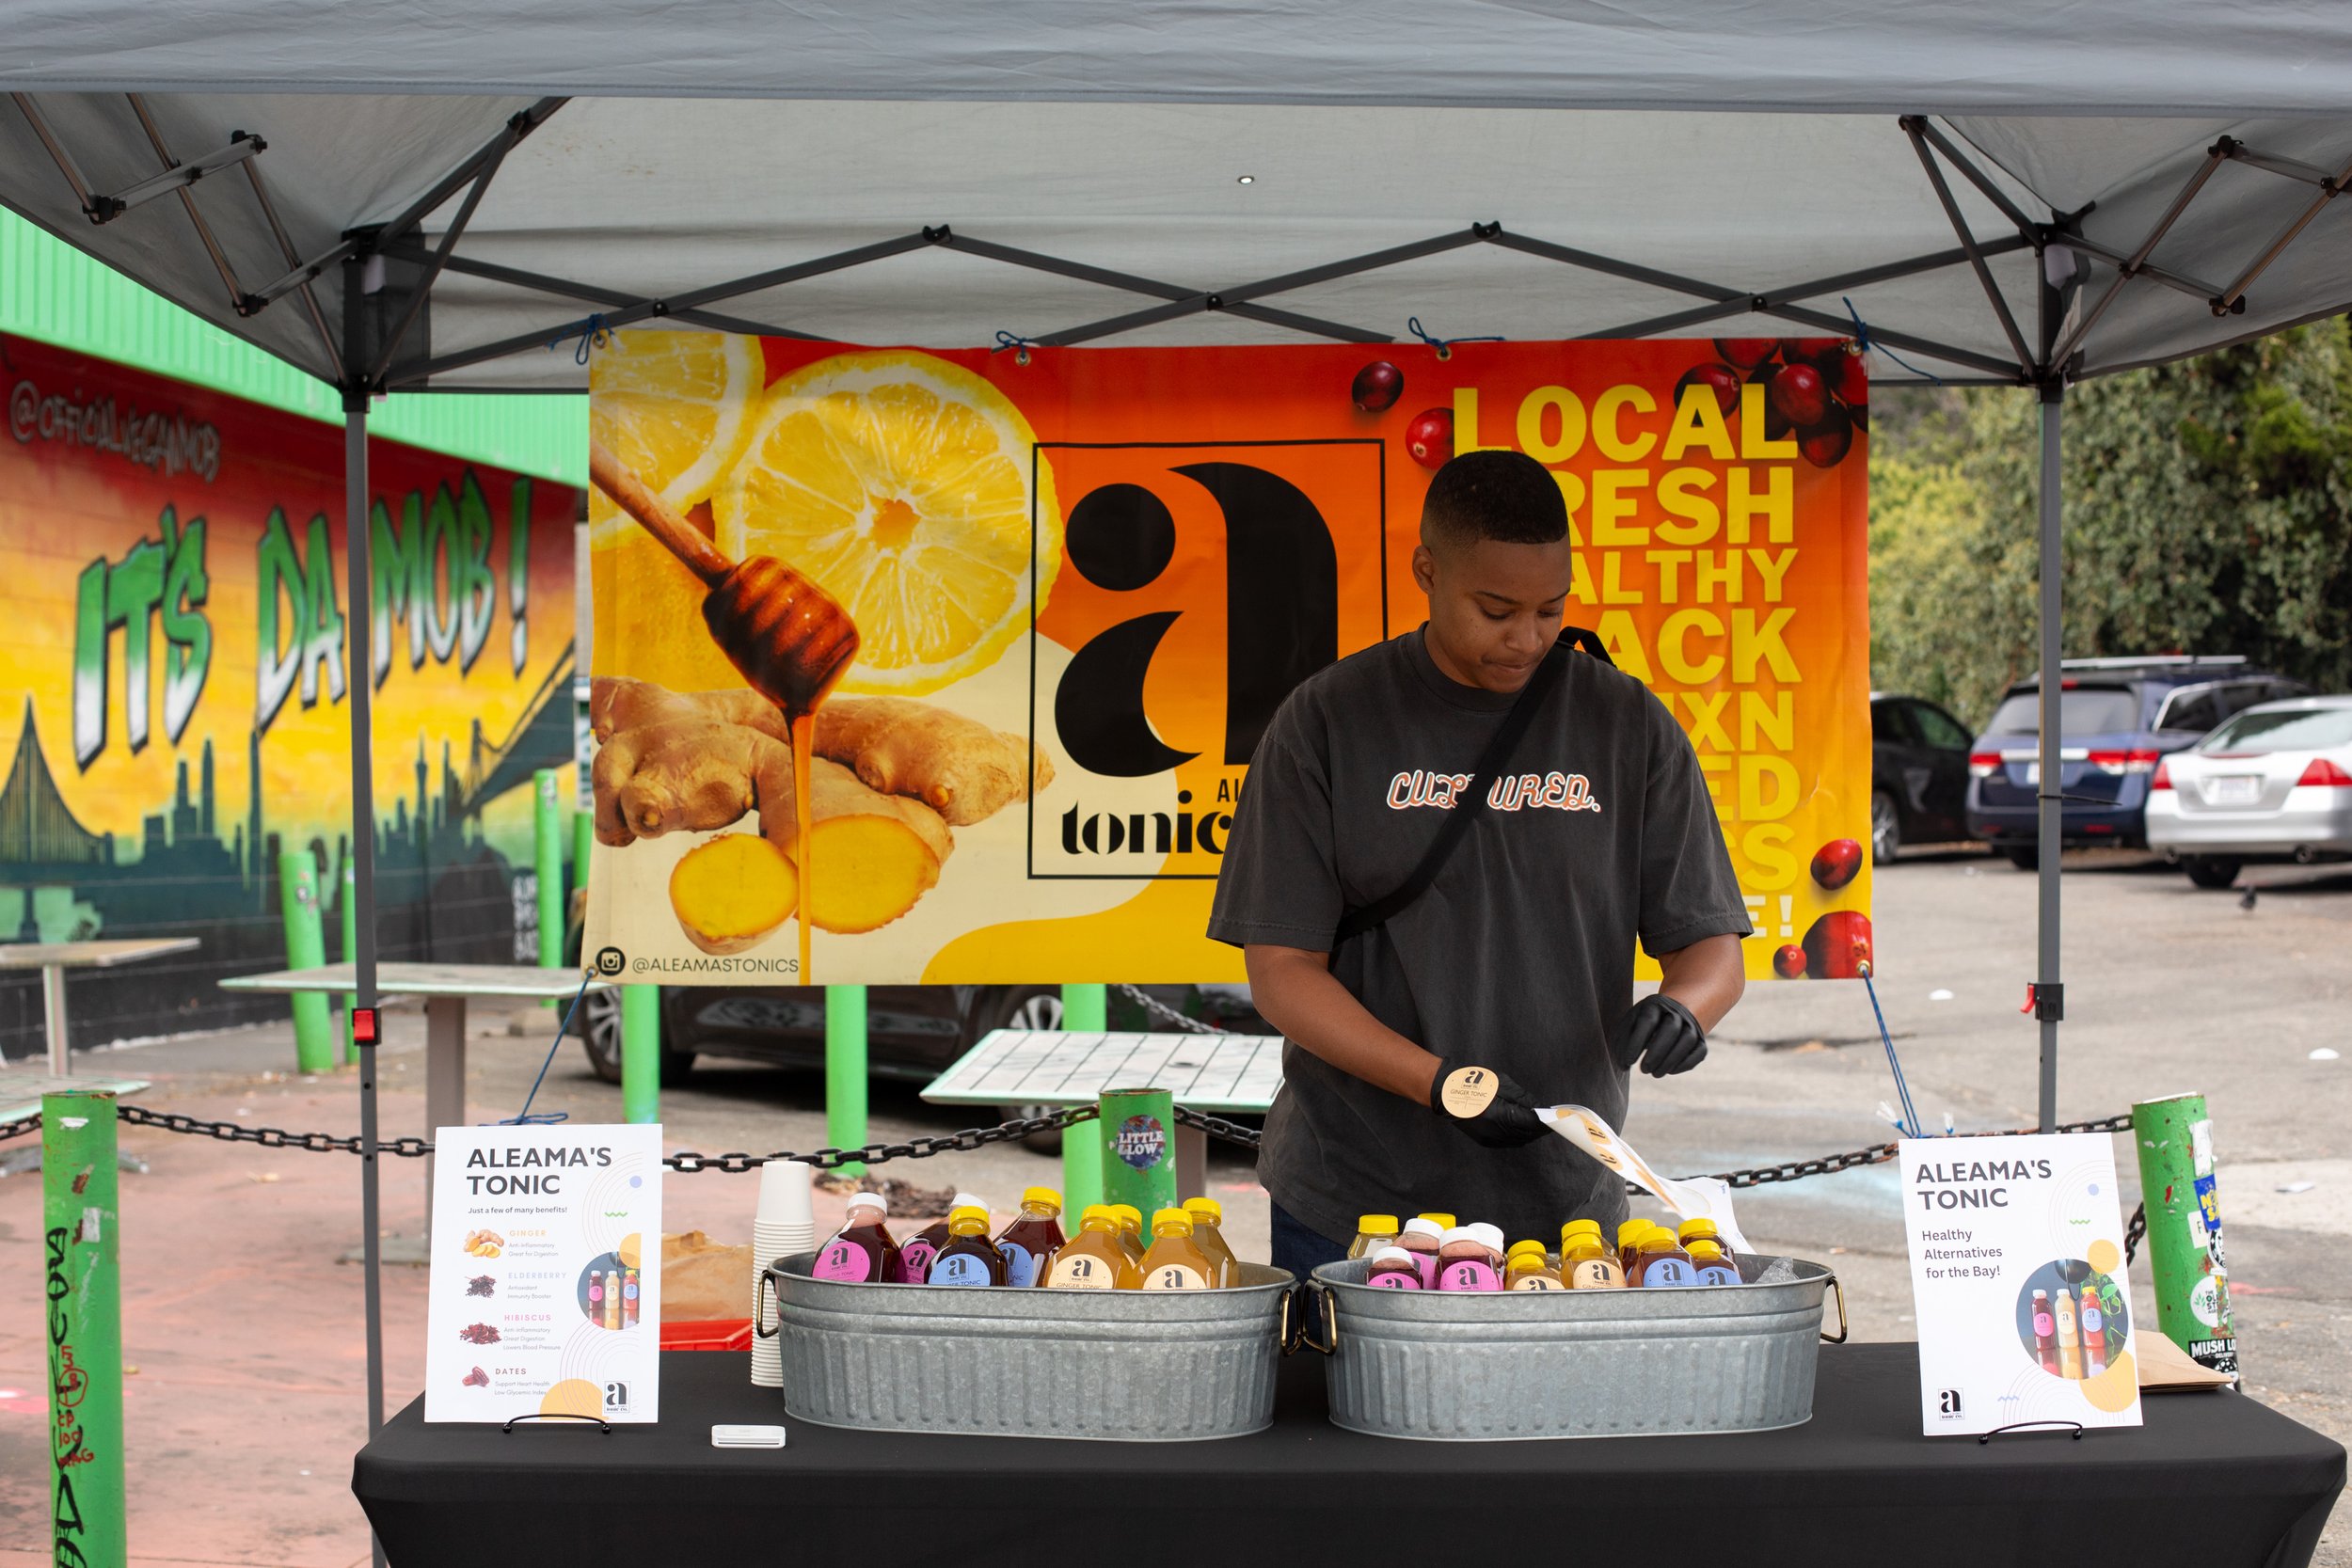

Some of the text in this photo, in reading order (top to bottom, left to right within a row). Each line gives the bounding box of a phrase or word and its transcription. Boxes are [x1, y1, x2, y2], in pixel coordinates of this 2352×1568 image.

[1454, 384, 1798, 463] LOCAL
[1552, 467, 1793, 546] RESH
[1569, 548, 1799, 605] ALTHY
[256, 506, 346, 741] DA
[1597, 608, 1803, 686] ACK
[1387, 769, 1601, 813] CULURED.
[1062, 789, 1232, 855] tonic
[632, 958, 799, 974] @ALEAMASTONICS
[1119, 1132, 1165, 1144] LITTLE
[467, 1147, 612, 1168] ALEAMA'S
[1915, 1159, 2052, 1183] ALEAMA'S
[467, 1175, 561, 1196] TONIC
[1917, 1188, 2009, 1211] TONIC
[1922, 1228, 1973, 1243] Healthy
[1924, 1246, 2003, 1260] Alternatives
[1926, 1265, 2001, 1279] for the Bay!
[2190, 1339, 2226, 1358] MUSH
